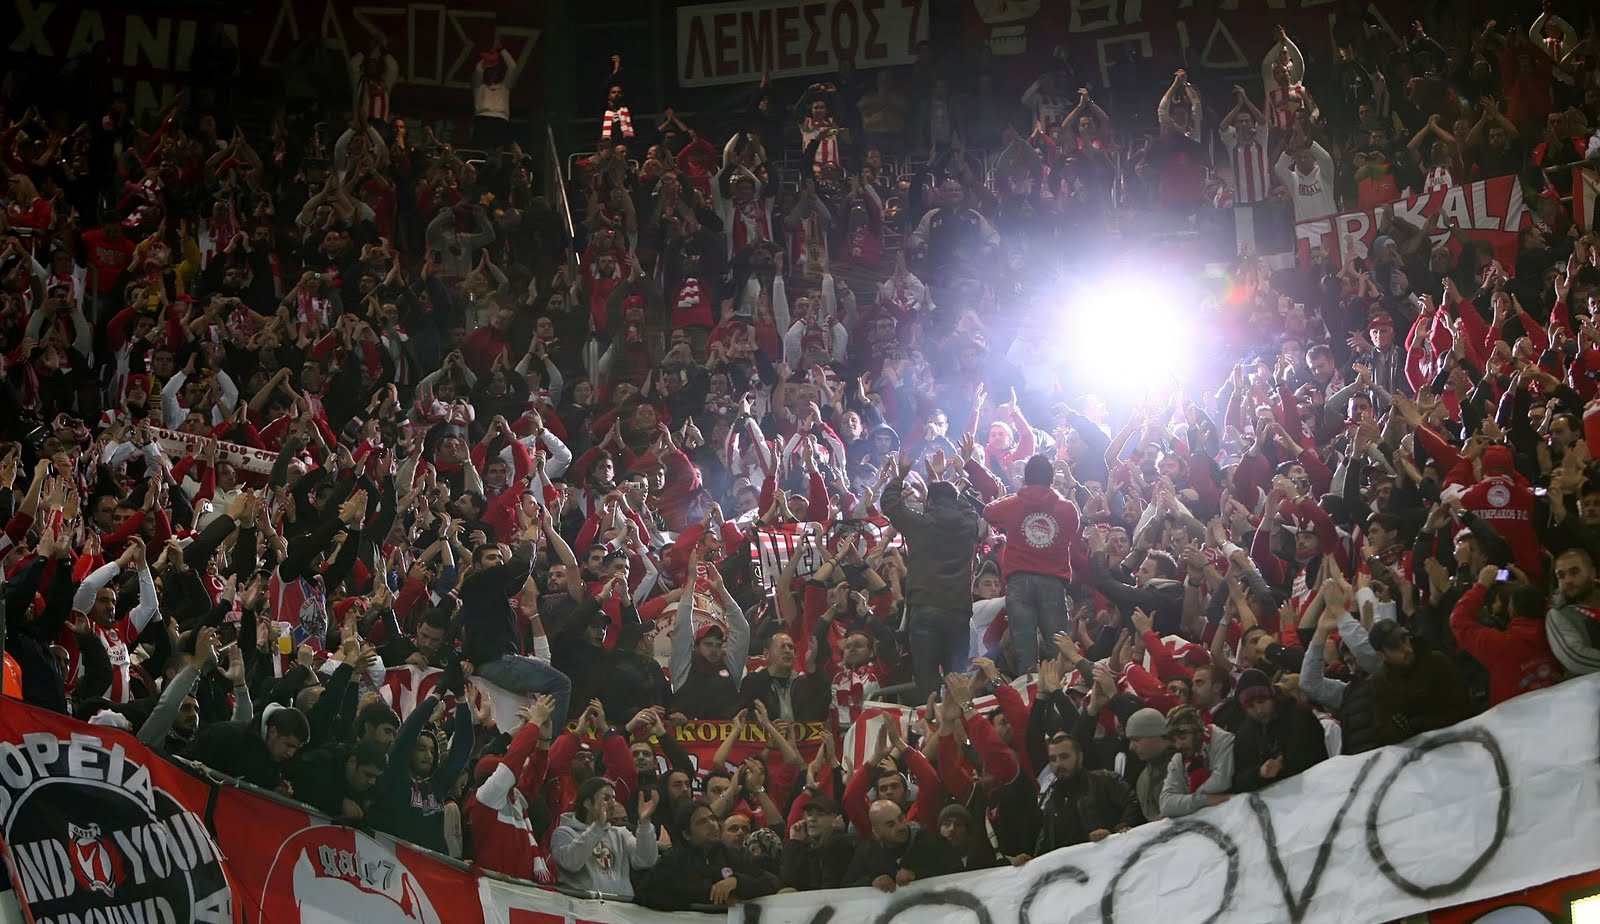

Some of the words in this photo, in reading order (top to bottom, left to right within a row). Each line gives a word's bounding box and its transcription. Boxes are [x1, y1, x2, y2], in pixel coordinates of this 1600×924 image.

[684, 0, 889, 79] ΛΕΜΕΣΟΣ
[159, 430, 248, 456] OLYMKOS
[675, 721, 824, 743] ΚΟΡΙΝΟΣ
